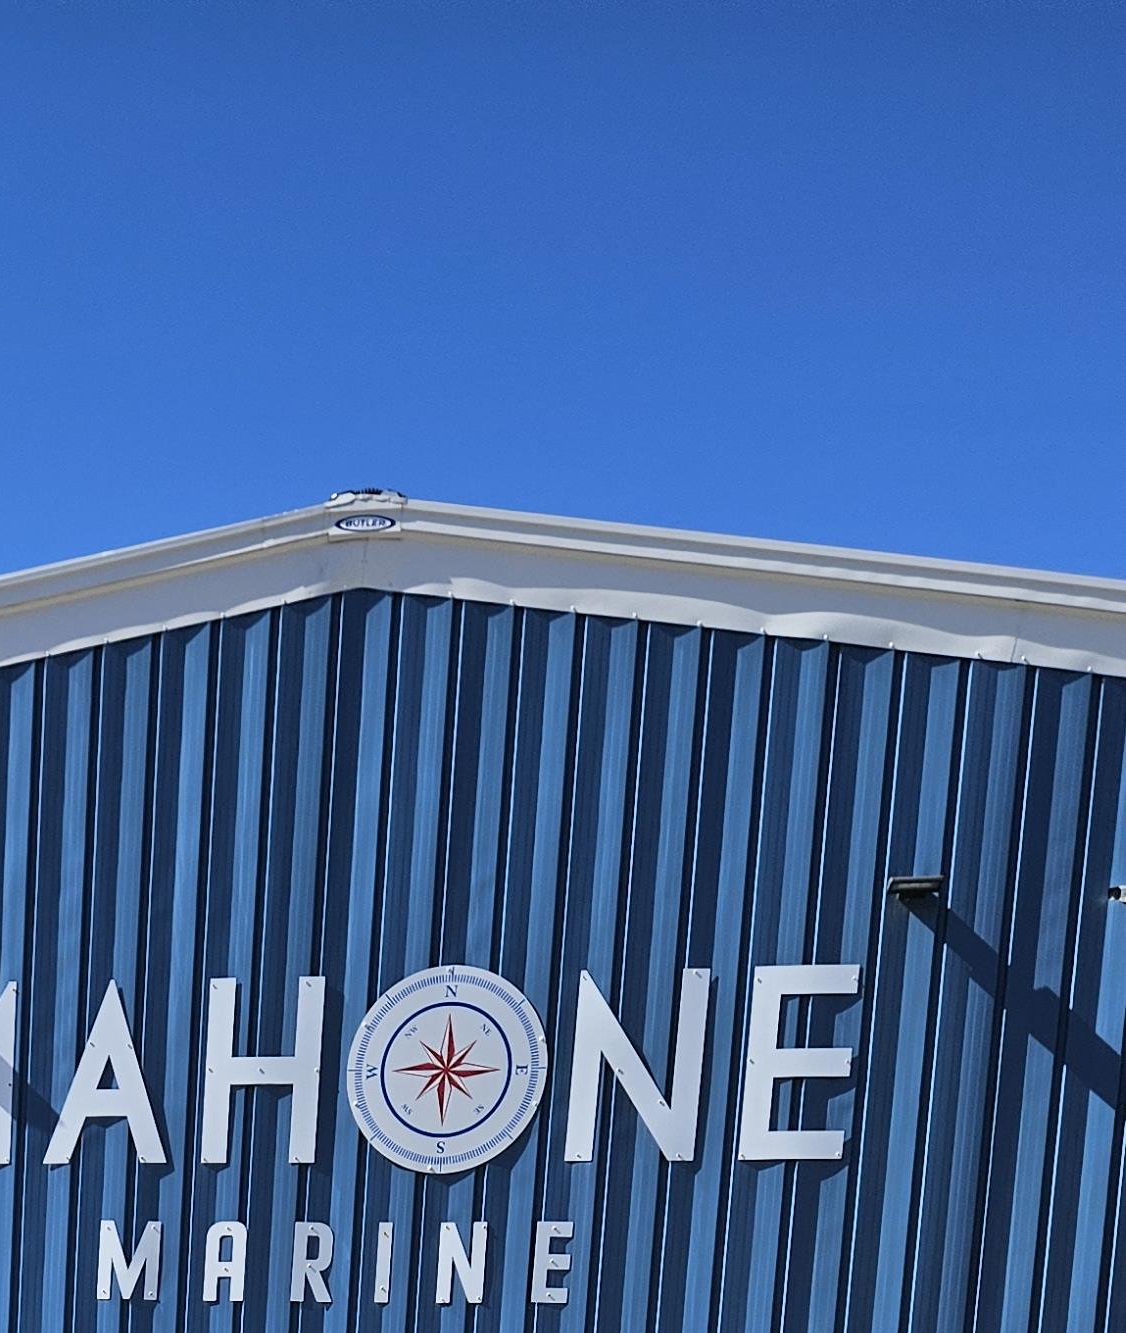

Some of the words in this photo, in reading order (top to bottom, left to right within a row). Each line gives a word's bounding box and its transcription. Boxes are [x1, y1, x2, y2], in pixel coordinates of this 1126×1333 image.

[445, 984, 459, 998] N
[404, 1025, 418, 1039] NW
[480, 1023, 492, 1037] NE
[366, 1063, 378, 1080] W
[515, 1063, 529, 1077] E
[401, 1103, 413, 1116] SW
[474, 1103, 485, 1116] SE
[436, 1140, 446, 1155] S
[97, 1219, 574, 1304] MARINE
